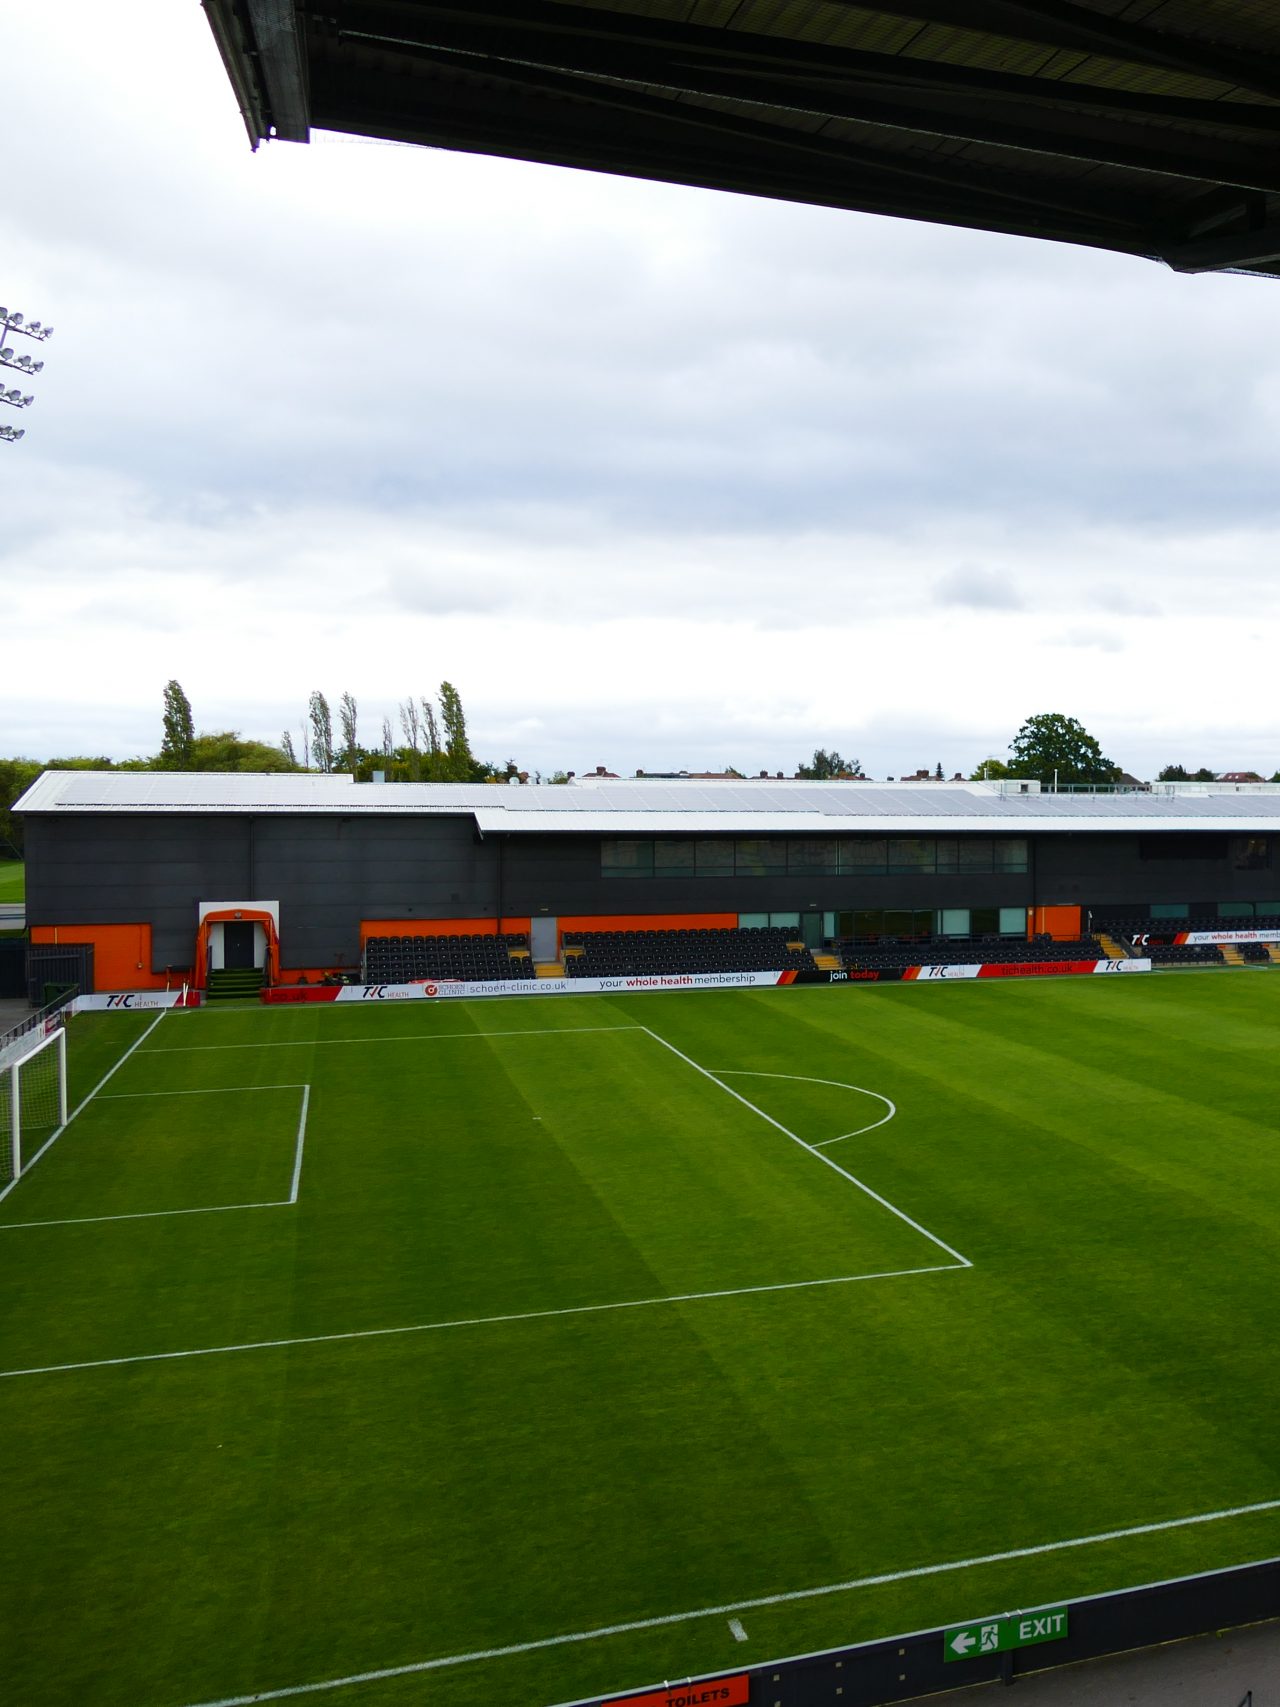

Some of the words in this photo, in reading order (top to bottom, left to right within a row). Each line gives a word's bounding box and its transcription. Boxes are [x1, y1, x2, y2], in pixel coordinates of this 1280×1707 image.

[1193, 934, 1209, 942] your
[829, 970, 847, 982] join
[849, 969, 880, 981] today
[1002, 964, 1073, 976] tichealth.co.uk
[470, 981, 567, 993] schoen-clinic.co.uk
[599, 979, 623, 989] your
[626, 977, 658, 987] whole
[660, 976, 693, 985] health
[694, 973, 755, 985] membership
[1019, 1613, 1065, 1641] EXIT
[665, 1687, 730, 1707] TOILETS
